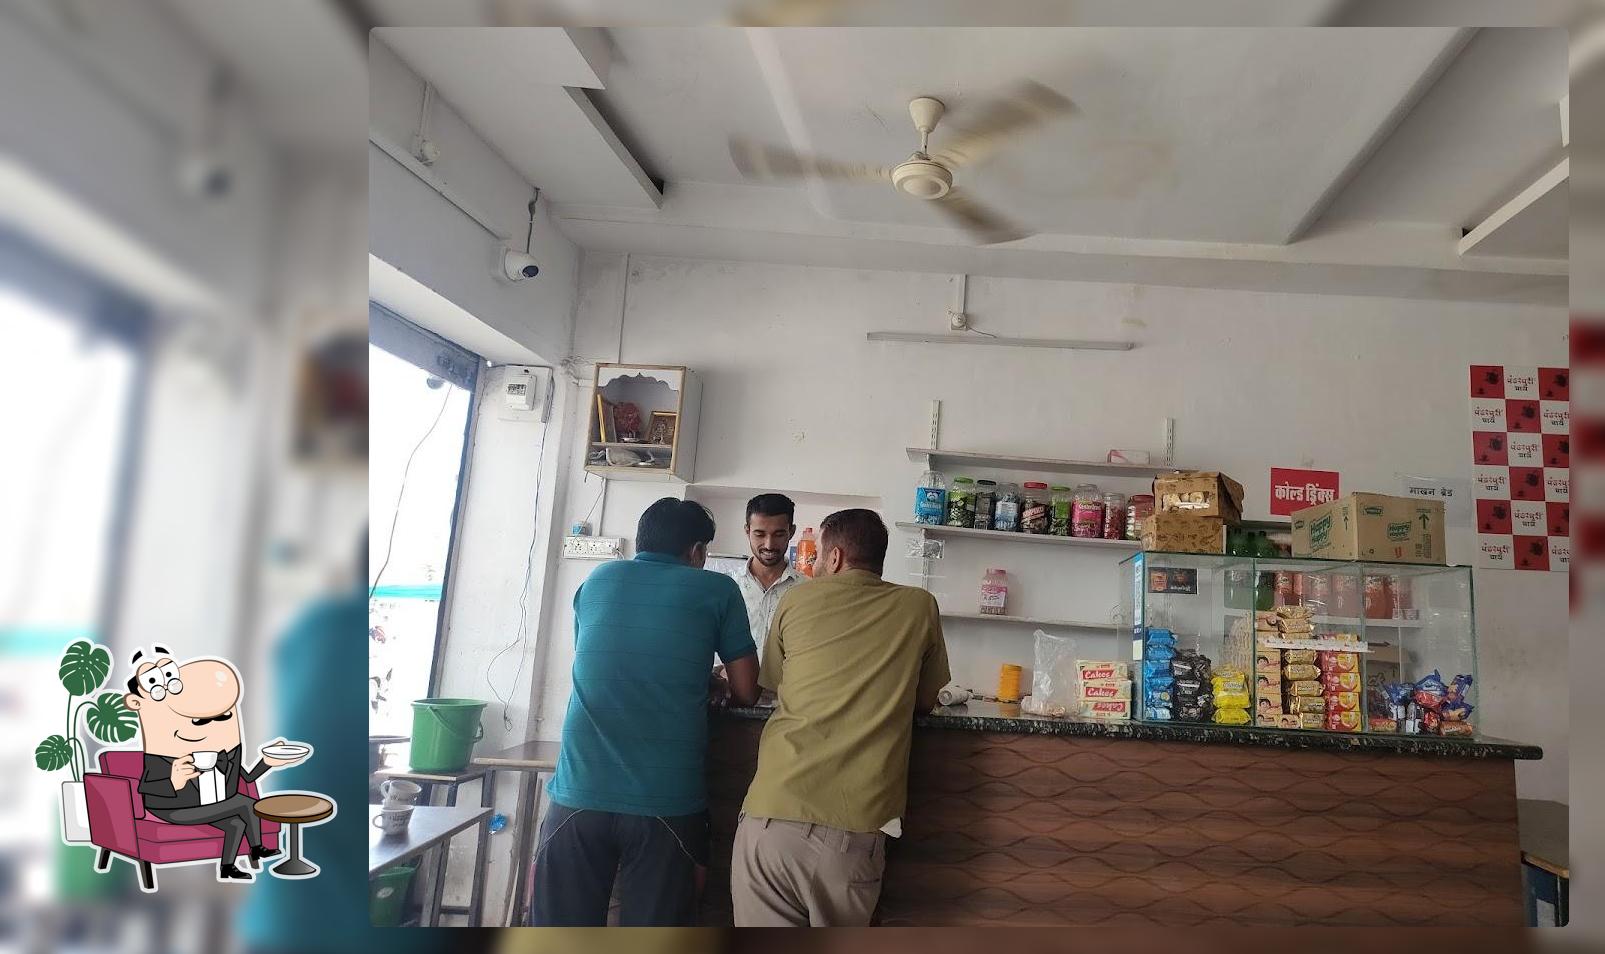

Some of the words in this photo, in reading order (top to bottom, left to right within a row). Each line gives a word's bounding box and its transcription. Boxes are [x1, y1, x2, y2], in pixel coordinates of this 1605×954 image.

[1274, 481, 1304, 501] कोल्ड
[1305, 483, 1335, 506] ड्रिंक्स
[1084, 670, 1111, 680] Cakes
[1087, 688, 1114, 697] Cakes
